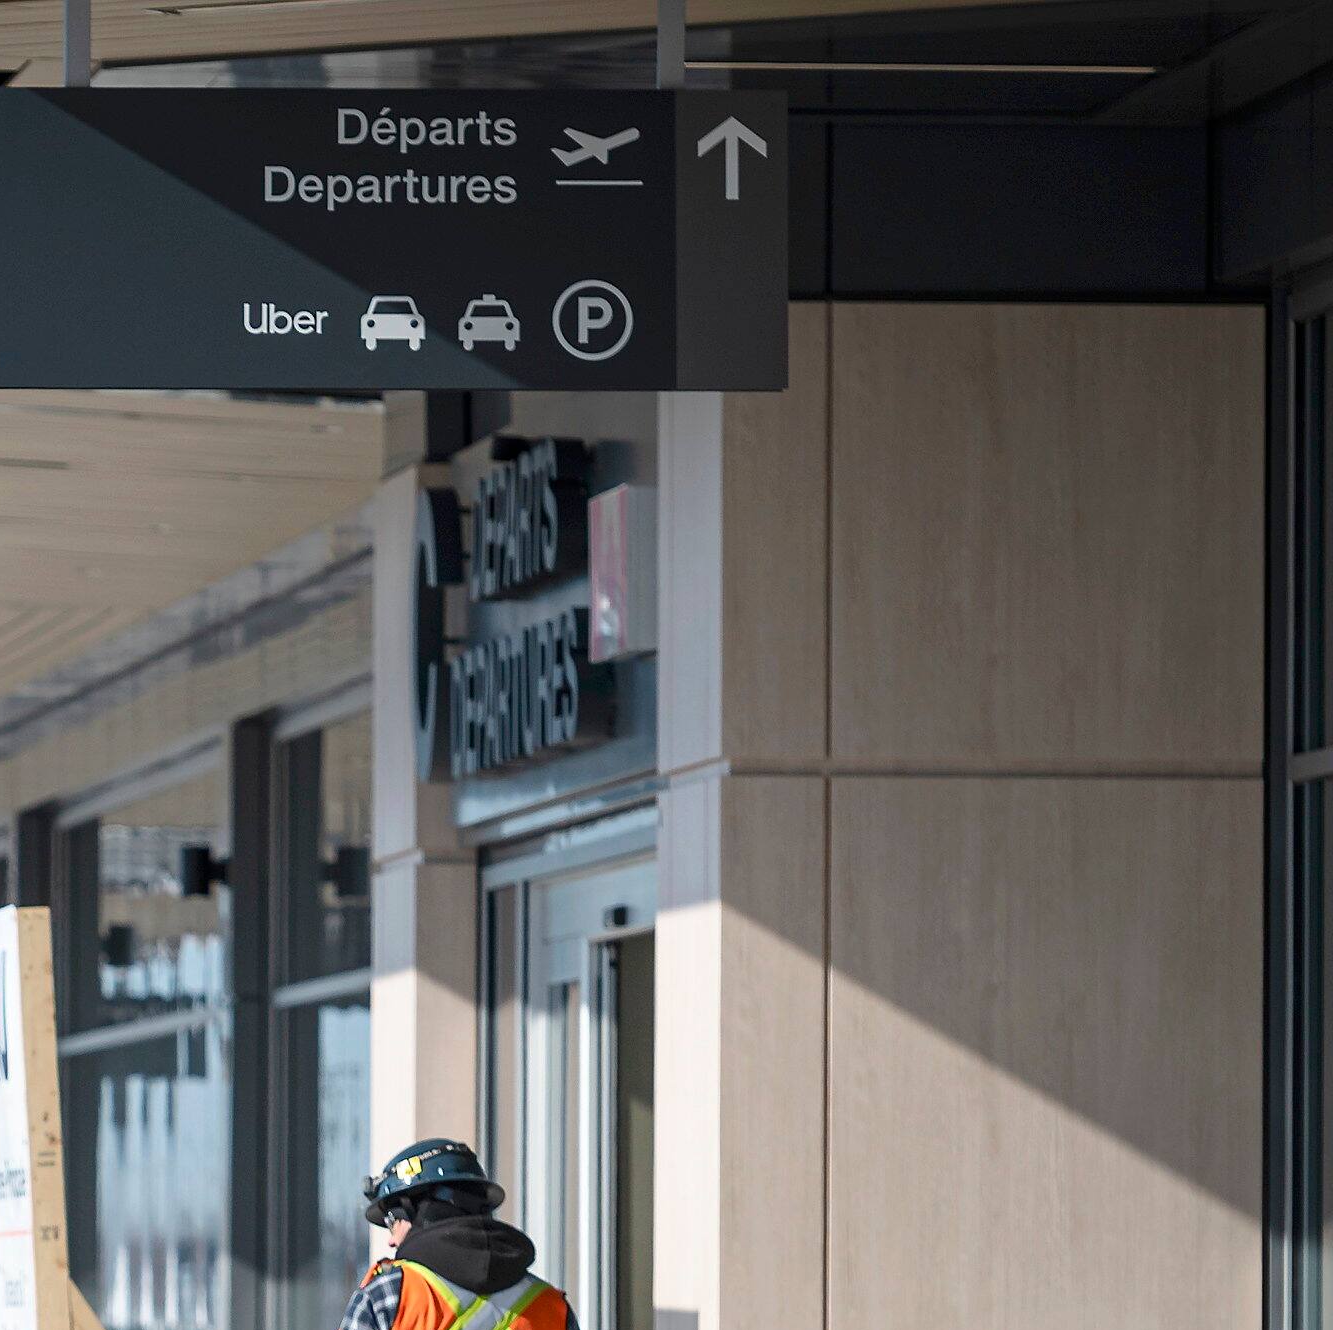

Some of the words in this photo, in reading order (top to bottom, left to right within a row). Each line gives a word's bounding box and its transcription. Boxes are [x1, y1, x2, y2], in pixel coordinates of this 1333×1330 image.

[337, 106, 518, 152] Départs
[264, 164, 518, 211] Departures
[243, 302, 329, 335] Uber
